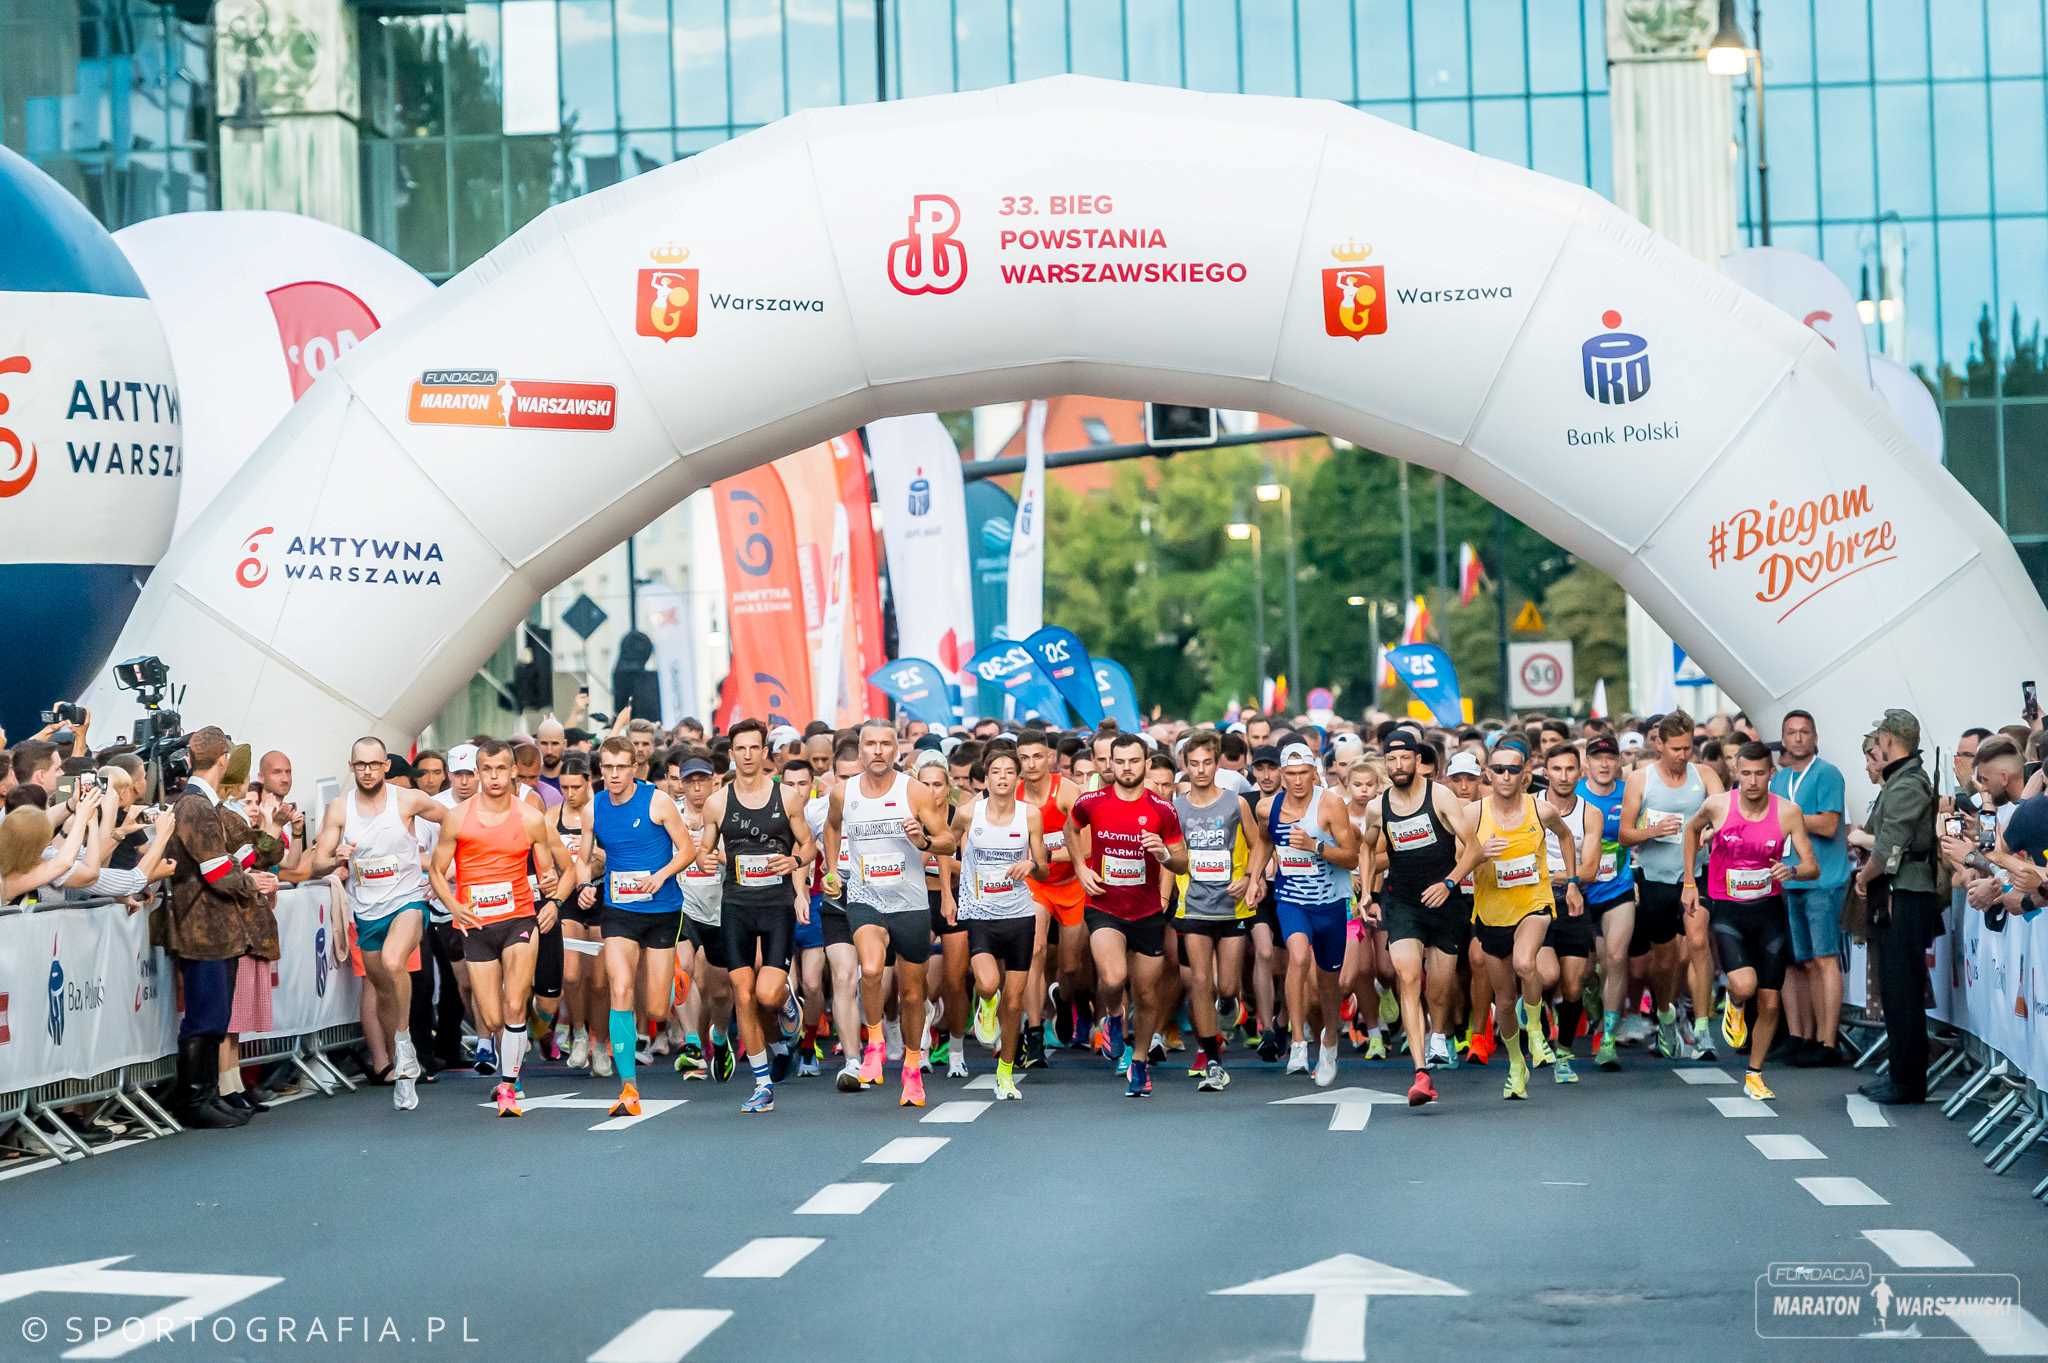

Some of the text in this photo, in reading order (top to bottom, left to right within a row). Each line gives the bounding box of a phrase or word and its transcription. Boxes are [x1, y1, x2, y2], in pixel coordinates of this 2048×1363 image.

[999, 195, 1113, 215] 33. BIEG
[1001, 229, 1167, 250] POWSTANIA
[1000, 263, 1247, 284] WARSZAWSKIEGO
[709, 293, 824, 312] Warszawa
[1397, 287, 1512, 305] Warszawa
[425, 372, 496, 384] FUNDACJA
[420, 393, 611, 417] MARATON WARSZAWSKI
[1567, 421, 1679, 446] Bank Polski
[1708, 484, 1874, 570] #Biegam
[287, 536, 444, 562] AKTYWNA
[286, 564, 442, 586] WARSZAWA
[1529, 663, 1556, 685] 30
[1104, 847, 1145, 857] GARMIN
